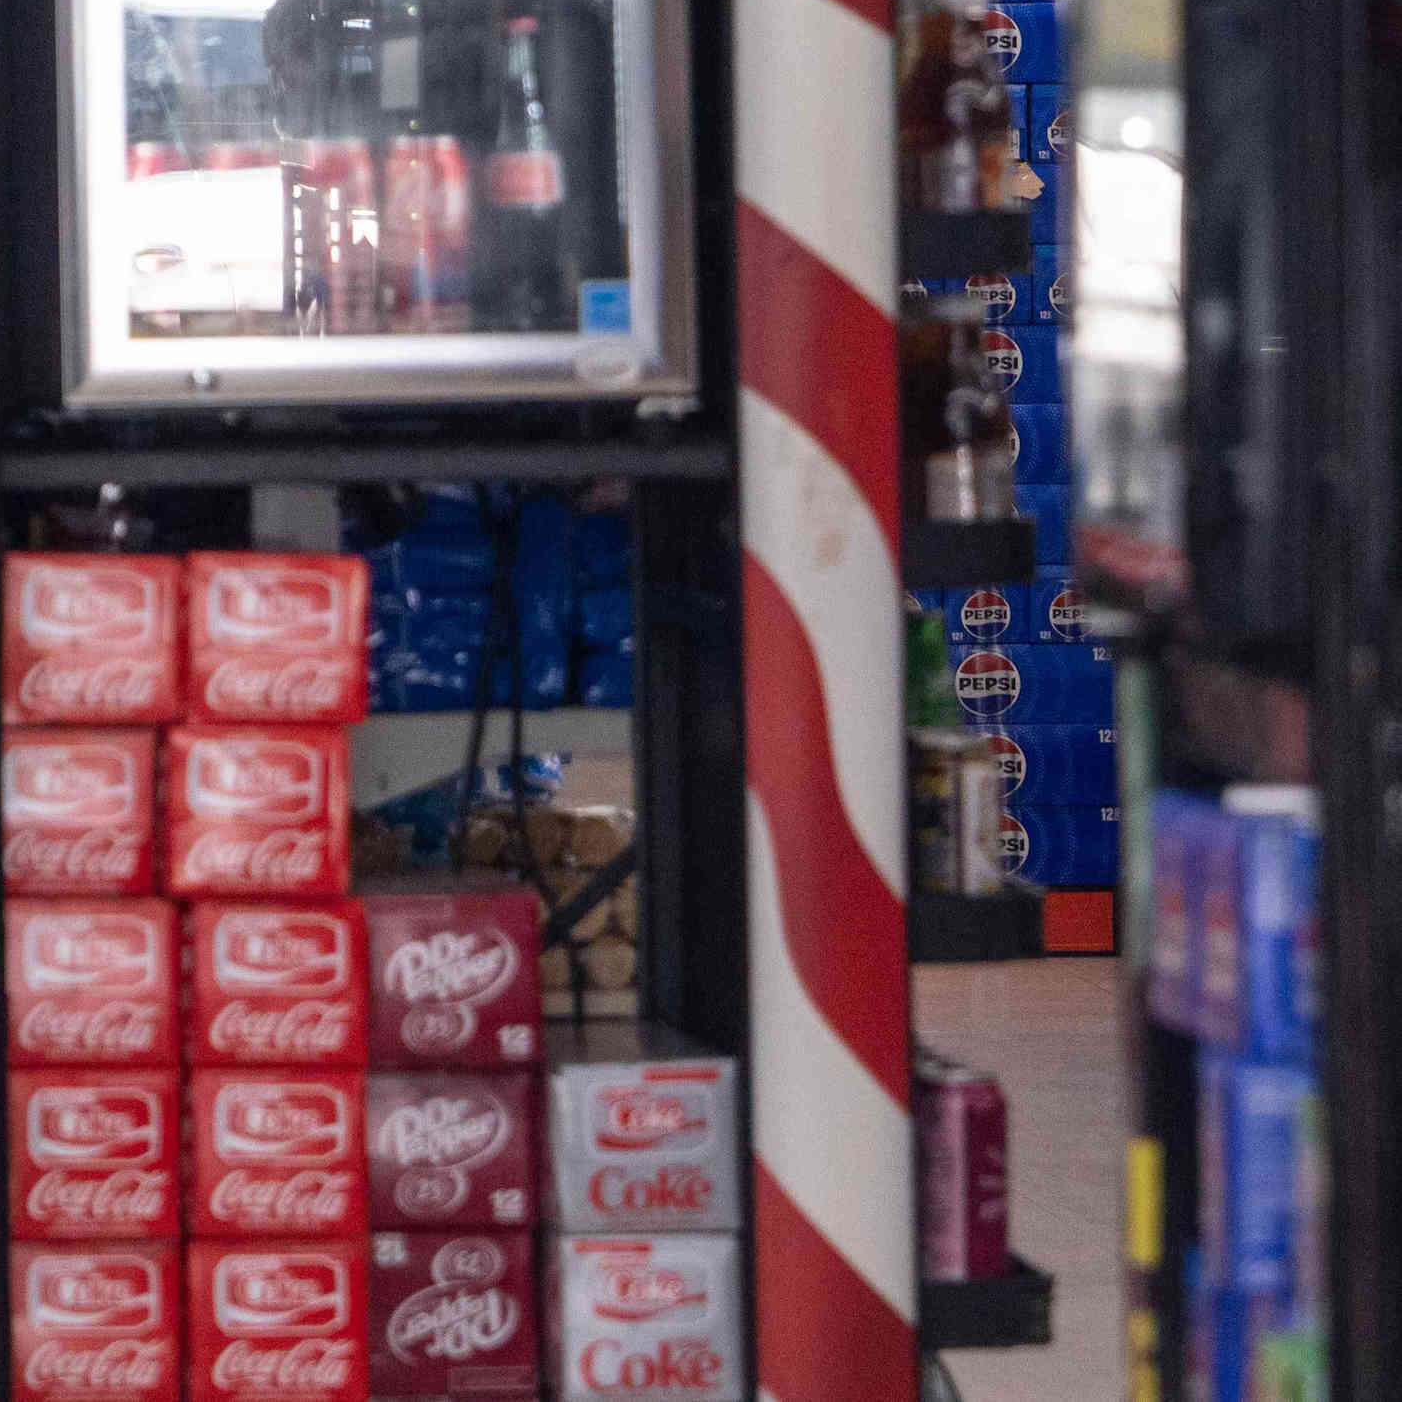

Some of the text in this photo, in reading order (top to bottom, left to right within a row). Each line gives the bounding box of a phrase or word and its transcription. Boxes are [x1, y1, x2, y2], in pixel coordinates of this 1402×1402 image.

[986, 35, 1018, 49] PSI
[987, 355, 1019, 370] PSI
[963, 608, 1008, 621] PEPSI
[1052, 608, 1085, 620] PEP
[958, 677, 1017, 691] PEPSI
[588, 1165, 712, 1215] Coke
[580, 1341, 721, 1393] Coke
